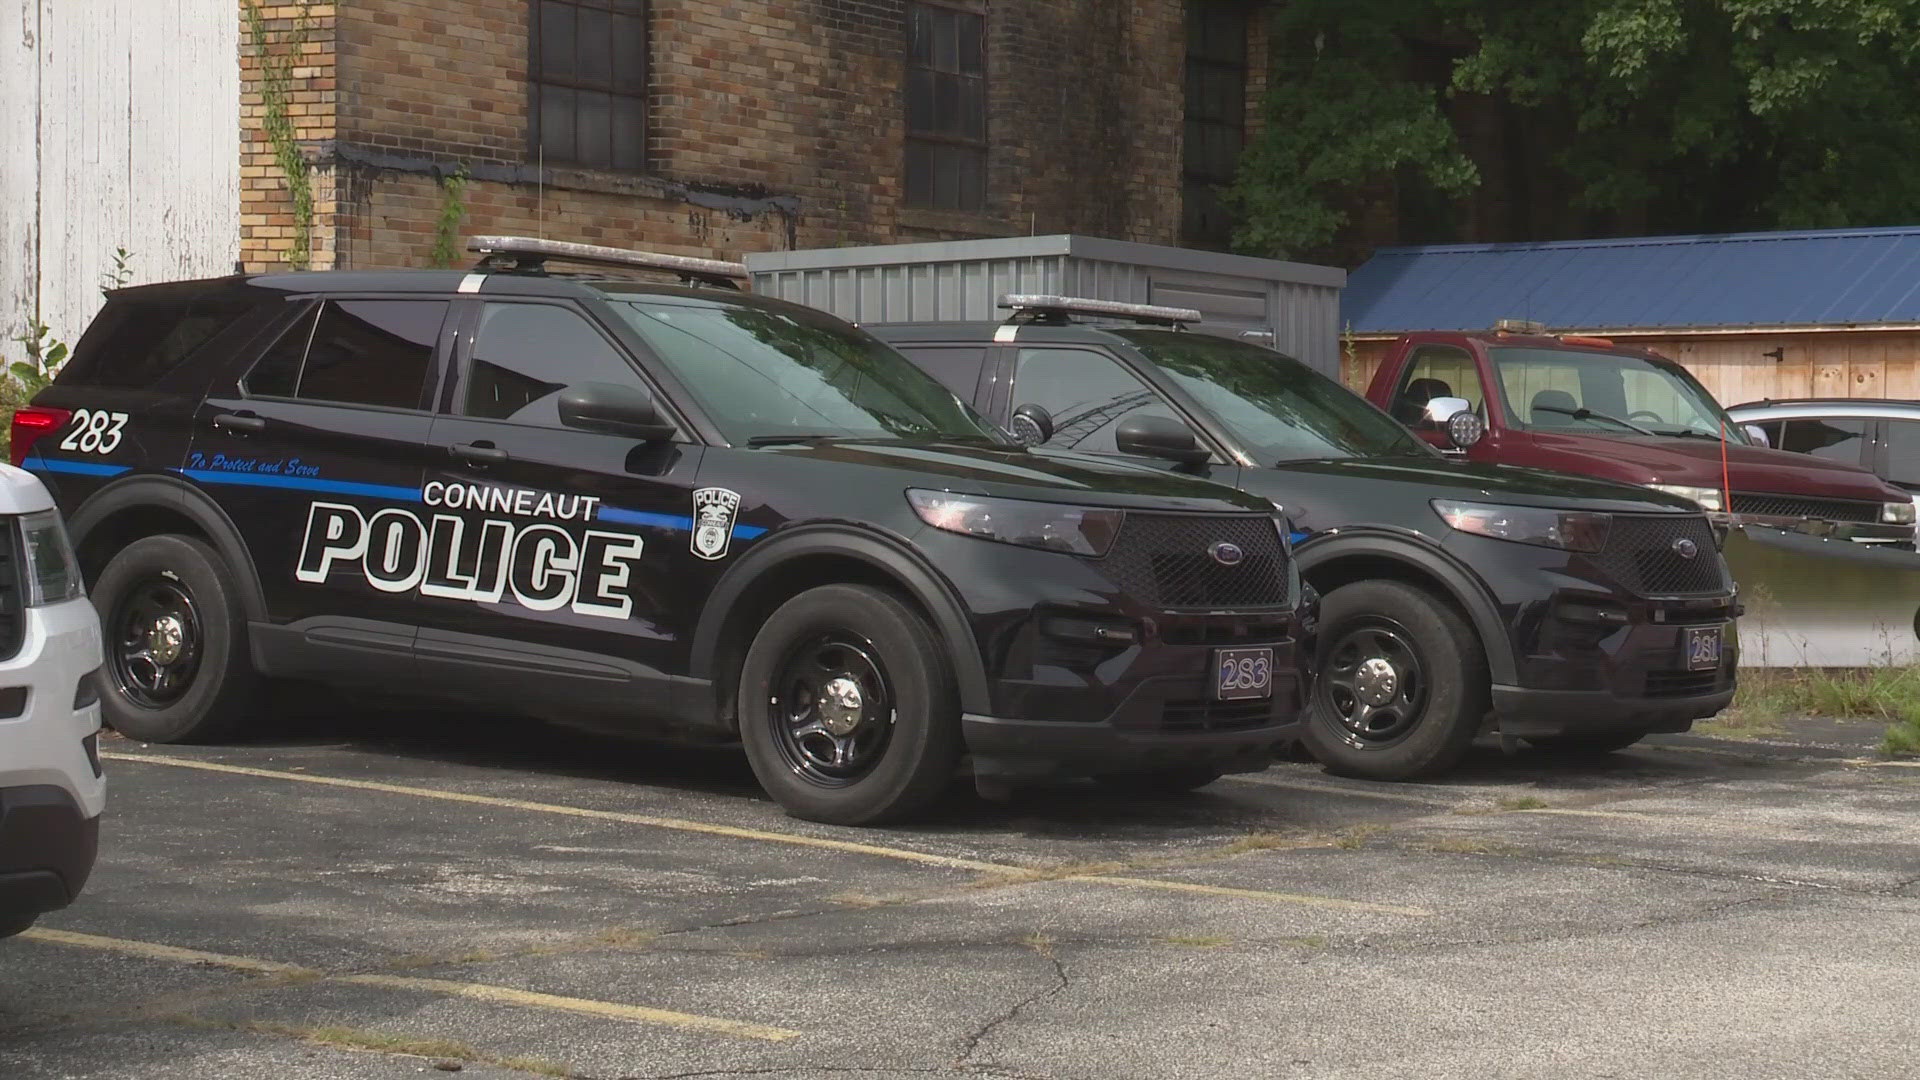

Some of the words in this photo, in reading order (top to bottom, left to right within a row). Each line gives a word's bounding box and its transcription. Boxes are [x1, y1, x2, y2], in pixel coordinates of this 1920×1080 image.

[60, 408, 129, 454] 283
[190, 453, 206, 469] To
[209, 454, 257, 471] Protect
[258, 459, 283, 473] and
[285, 458, 319, 476] Serve
[423, 481, 600, 521] CONNEAUT
[696, 490, 738, 510] POLICE
[295, 501, 644, 620] POLICE
[1691, 634, 1719, 663] 281
[1221, 658, 1269, 690] 283
